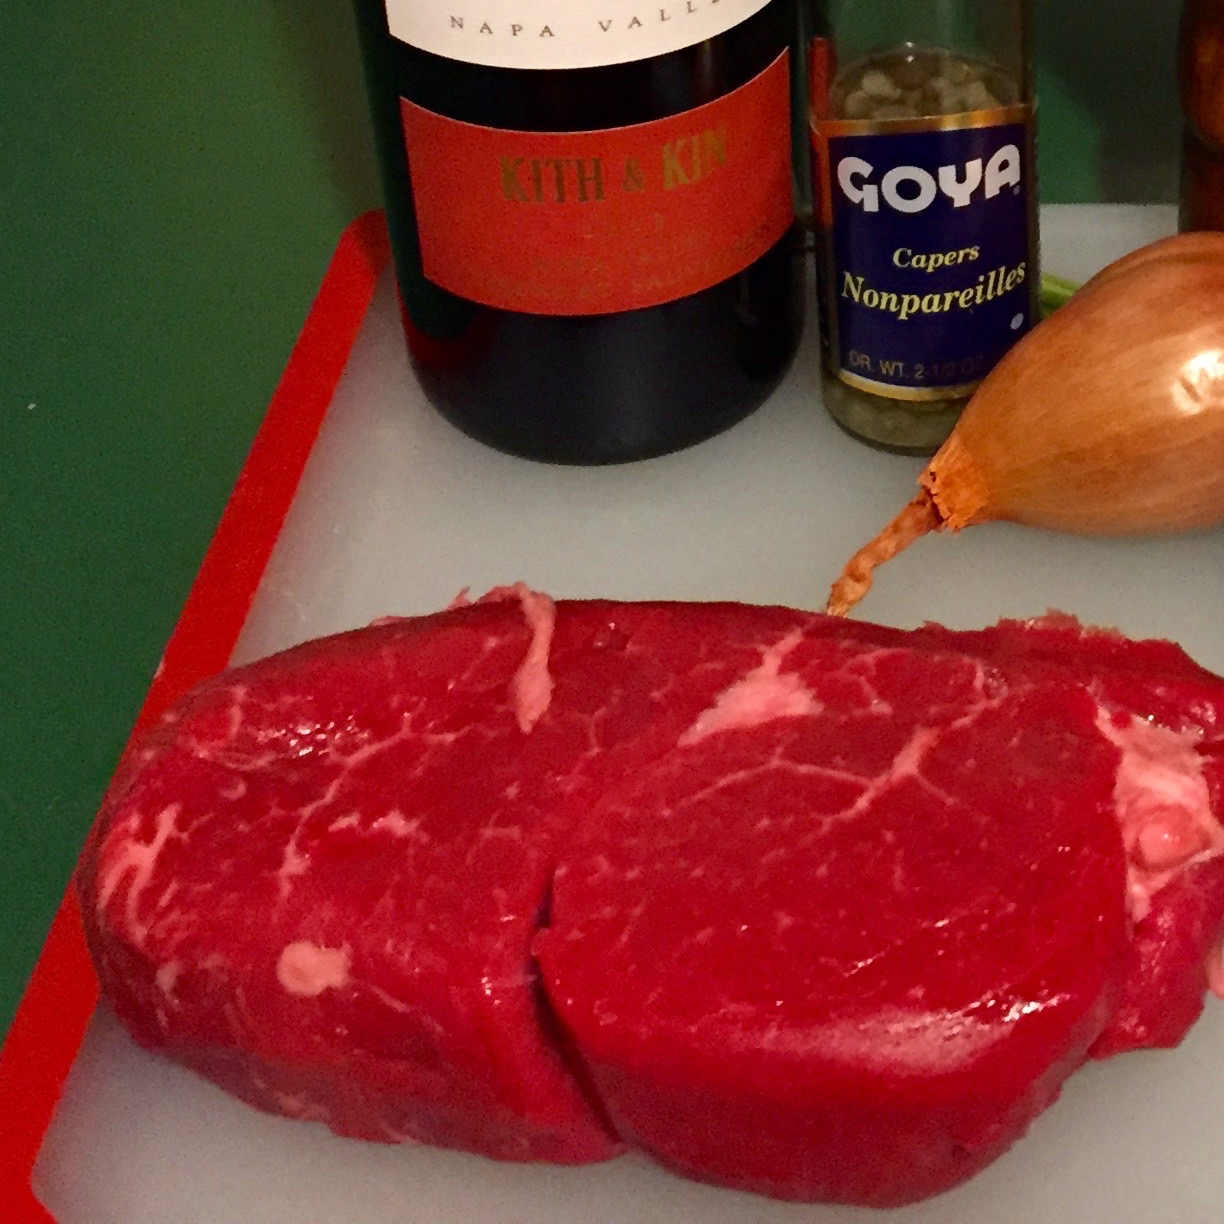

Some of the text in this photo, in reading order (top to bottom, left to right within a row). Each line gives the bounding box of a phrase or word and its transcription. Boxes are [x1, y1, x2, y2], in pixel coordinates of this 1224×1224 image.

[449, 14, 556, 39] NAPA
[499, 127, 729, 204] KITH & KIN
[836, 143, 1022, 213] GOYA
[892, 244, 981, 273] Capers
[841, 261, 1027, 321] Nonpareilles
